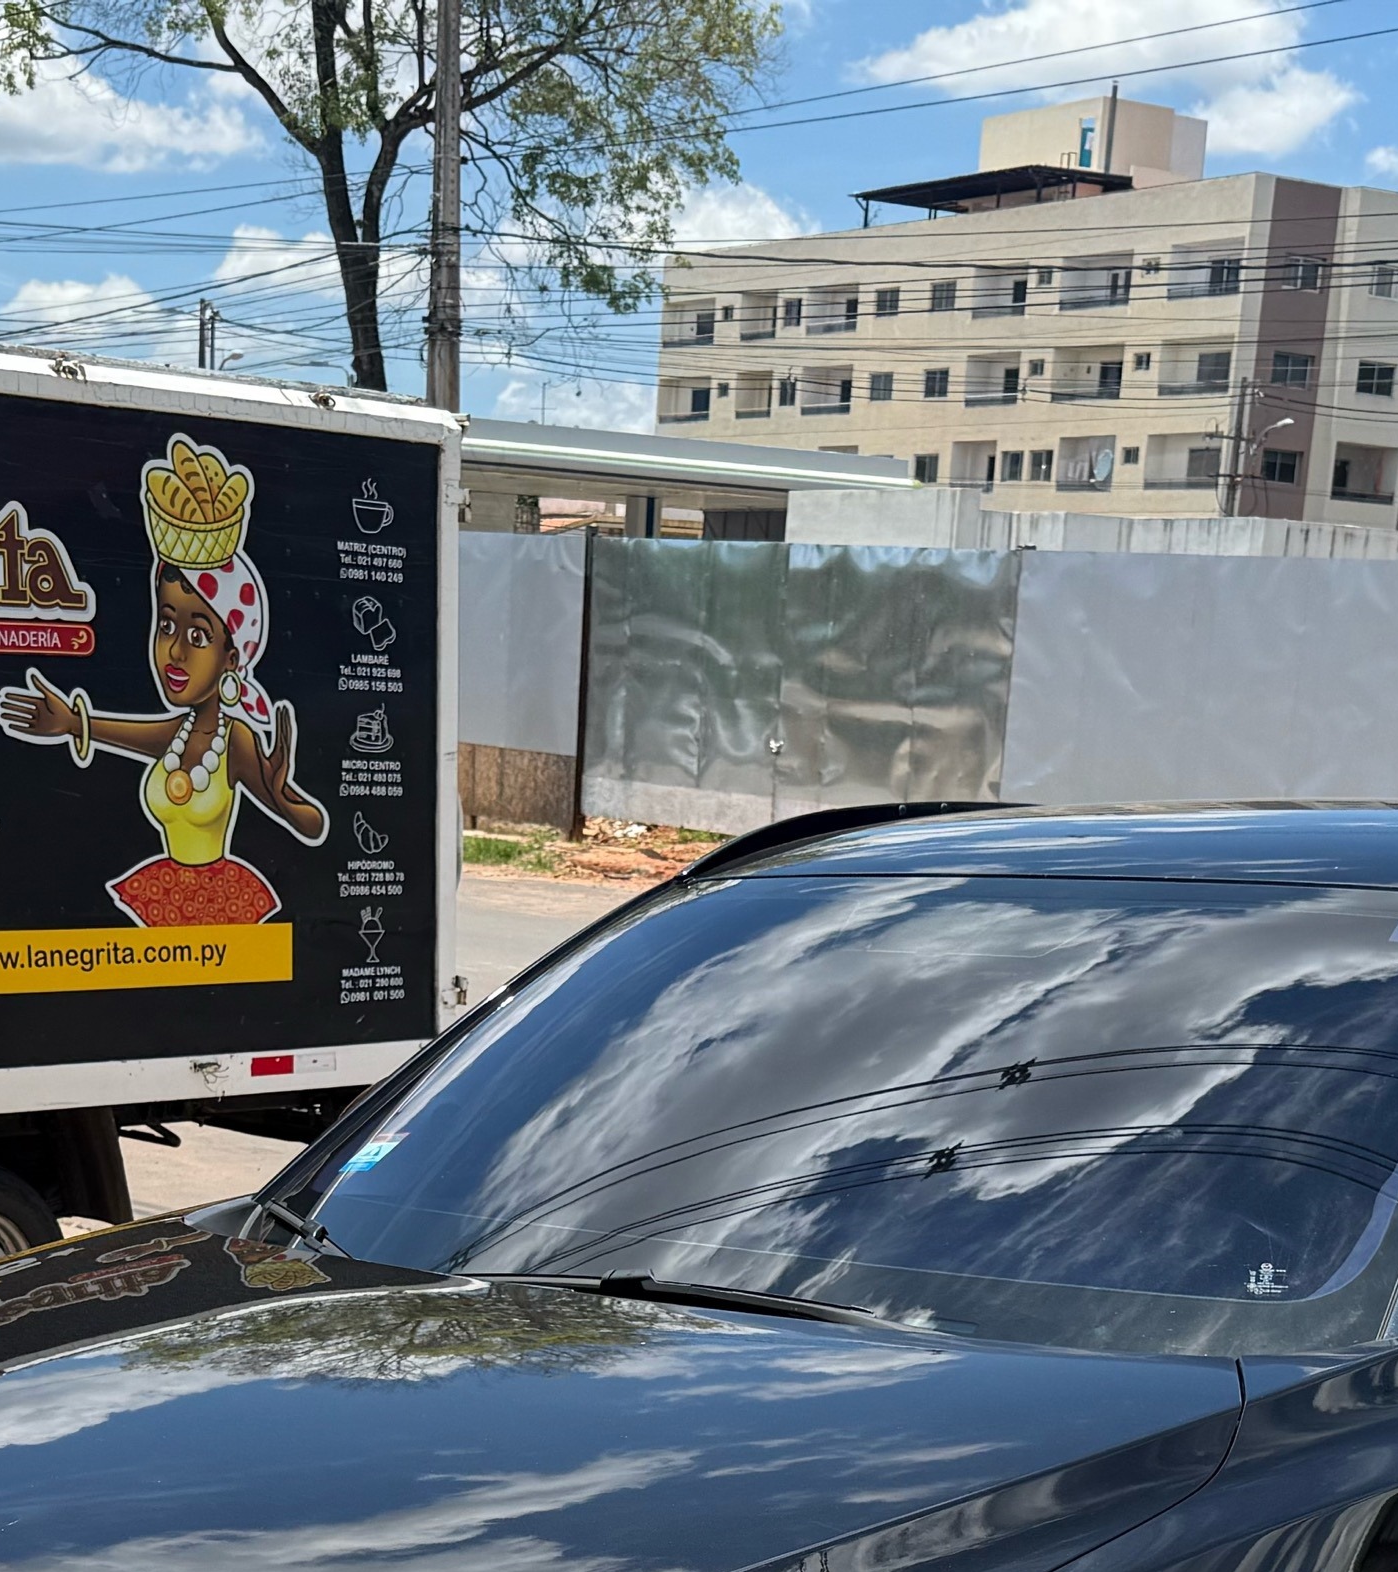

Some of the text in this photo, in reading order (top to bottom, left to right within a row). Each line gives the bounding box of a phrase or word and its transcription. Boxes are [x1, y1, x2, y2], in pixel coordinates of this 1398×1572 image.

[337, 541, 406, 558] MATRIZ (CENTRO)
[357, 556, 371, 566] 021
[351, 654, 389, 665] LAMBARÉ
[357, 667, 370, 676] 021
[387, 682, 403, 692] 503
[342, 760, 401, 771] MICRO CENTRO
[358, 773, 371, 782] 021
[347, 859, 395, 870] HIPÓDROMO
[342, 965, 401, 977] MADAME LYNCH
